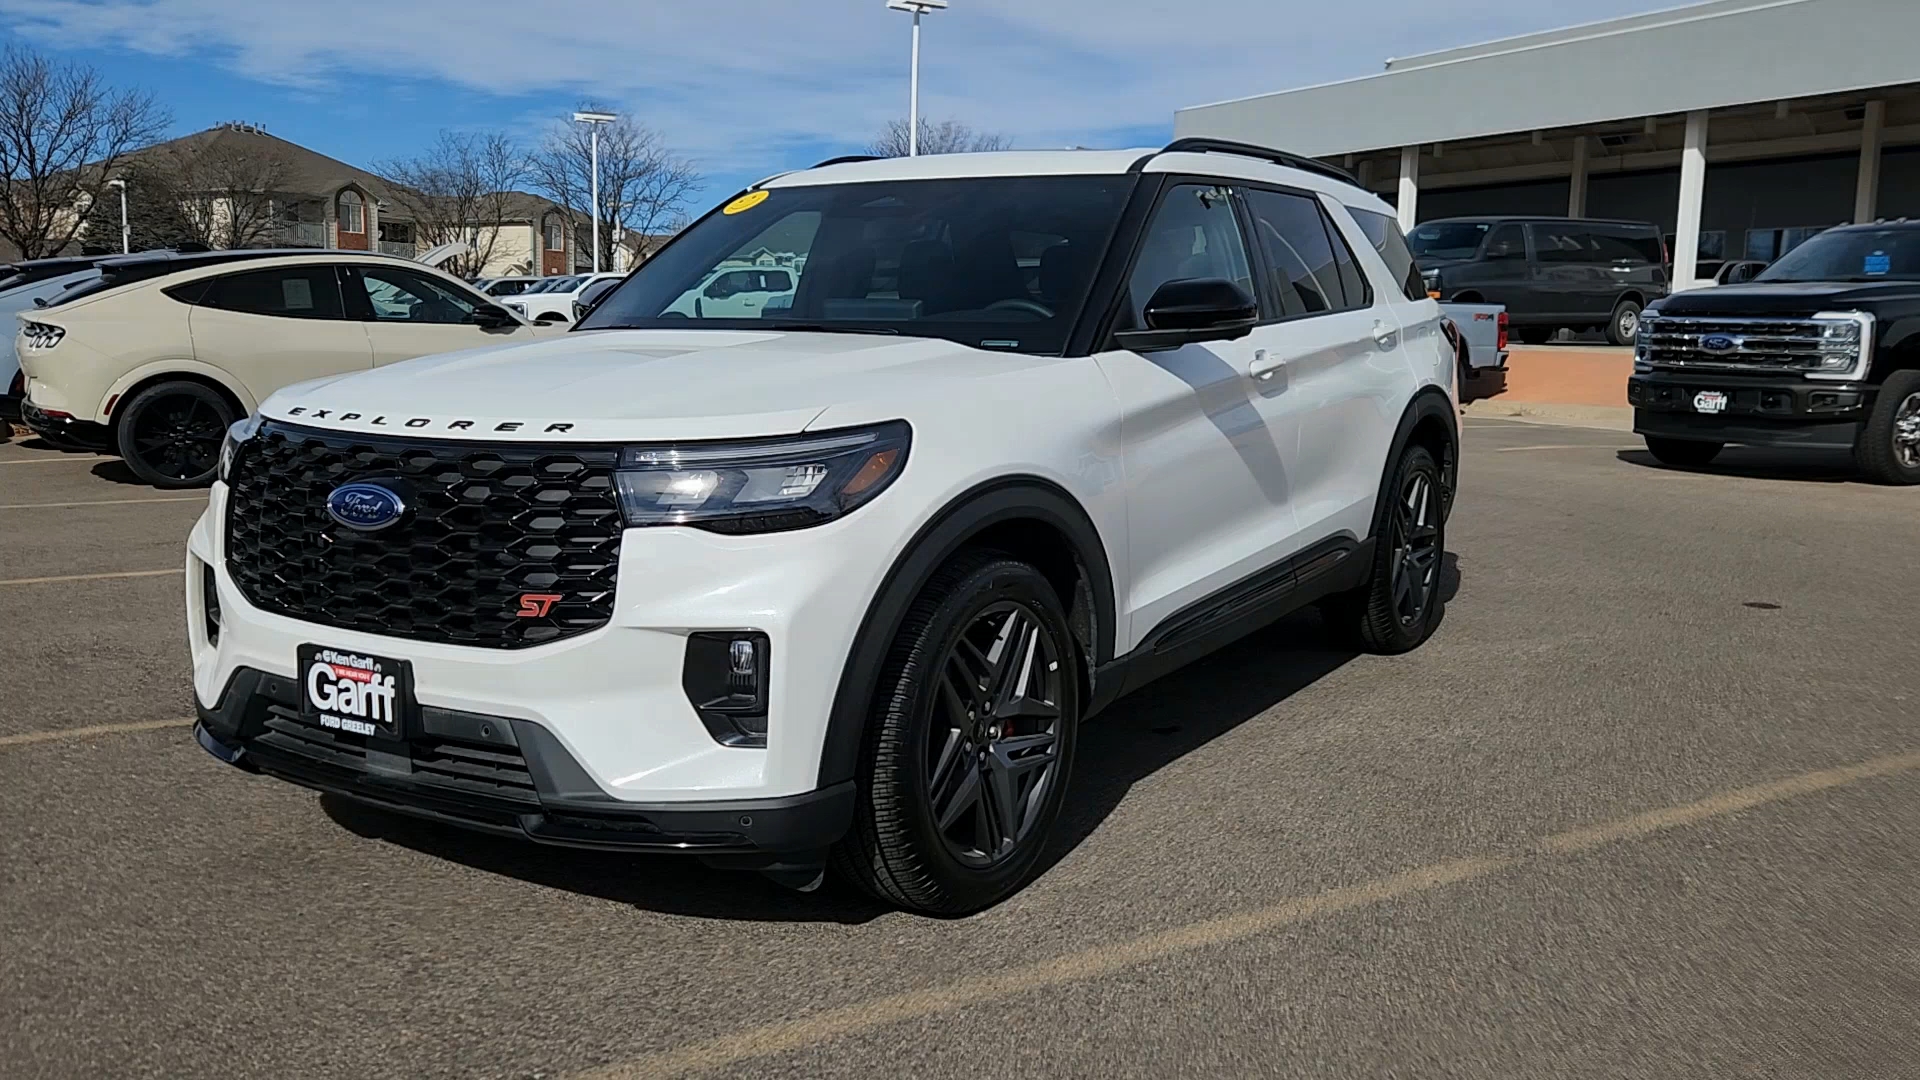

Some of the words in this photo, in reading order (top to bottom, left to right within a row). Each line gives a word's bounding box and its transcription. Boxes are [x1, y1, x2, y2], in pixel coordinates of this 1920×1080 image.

[288, 407, 574, 433] EXPLORER
[344, 491, 383, 513] Ford
[516, 594, 563, 617] ST
[308, 662, 395, 723] Garff
[320, 714, 340, 729] FORD
[341, 718, 376, 736] GREELEY
